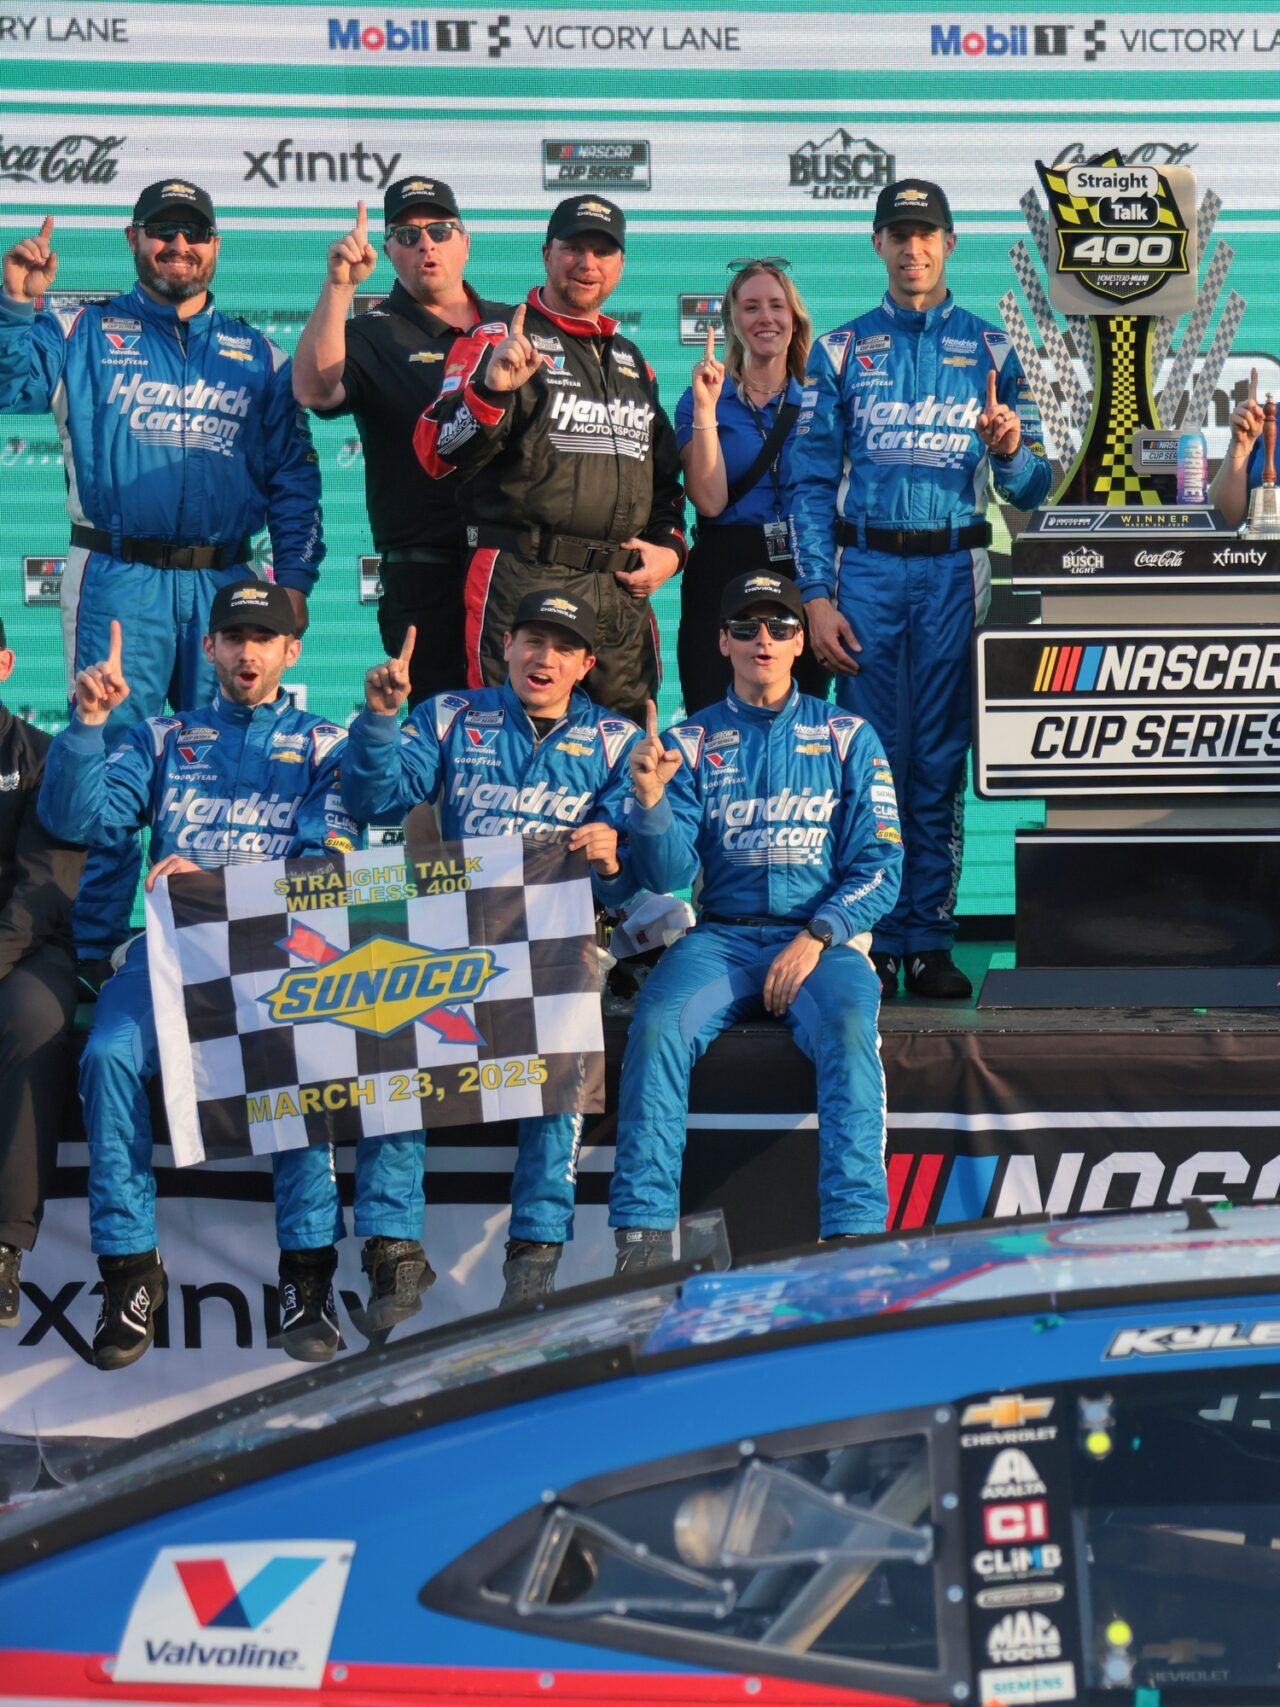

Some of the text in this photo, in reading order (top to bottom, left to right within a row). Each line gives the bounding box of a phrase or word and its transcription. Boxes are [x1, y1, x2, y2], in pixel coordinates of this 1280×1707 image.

[46, 18, 129, 42] LANE
[329, 19, 428, 51] Mobil
[525, 25, 654, 50] VICTORY
[663, 27, 741, 50] LANE
[930, 24, 1028, 56] Mobil
[1120, 28, 1245, 53] VICTORY
[243, 138, 401, 188] xfinity
[576, 145, 633, 159] NASCAR
[558, 165, 635, 181] CUP SERIES
[788, 153, 897, 186] BUSCH
[811, 185, 872, 200] LIGHT
[1077, 173, 1149, 192] Straight
[1111, 204, 1149, 221] Talk
[1072, 236, 1173, 265] 400
[942, 335, 979, 349] Hendrick
[101, 358, 149, 366] GOODYEAR
[107, 373, 252, 418] Hendrick
[129, 406, 240, 439] Cars.com
[551, 392, 656, 432] Hendrick
[852, 393, 982, 437] Hendrick
[571, 423, 650, 442] MOTORSPORTS
[866, 427, 972, 452] Cars.com
[1158, 440, 1179, 450] NASC
[1164, 451, 1179, 460] SER
[1120, 514, 1190, 524] WINNER
[1062, 554, 1105, 570] BUSCH
[1134, 550, 1186, 567] Coca-Cola
[1212, 548, 1268, 567] xfinity
[744, 586, 782, 594] CHEVROLET
[230, 599, 269, 608] CHEVROLET
[540, 607, 577, 621] CHEVROLET
[1030, 715, 1128, 760] CUP
[454, 757, 502, 767] GOODYEAR
[168, 772, 218, 783] GOODYEAR
[450, 772, 593, 823] Hendrick
[705, 786, 841, 828] Hendrick
[723, 825, 829, 850] Cars.com
[274, 865, 407, 896] STRAIGHT
[416, 857, 484, 880] TALK
[286, 876, 472, 914] WIRELESS 400
[280, 957, 488, 1016] SUNOCO
[245, 1059, 549, 1125] MARCH 23, 2025
[961, 1426, 1058, 1448] CHEVROLET
[980, 1482, 1047, 1499] AXALTA
[985, 1502, 1046, 1541] CI
[973, 1544, 1063, 1576] CLIMB
[987, 1609, 1062, 1650] MAC
[143, 1638, 301, 1672] Valvoline
[989, 1643, 1063, 1664] TOOLS
[992, 1677, 1064, 1695] SIEMENS
